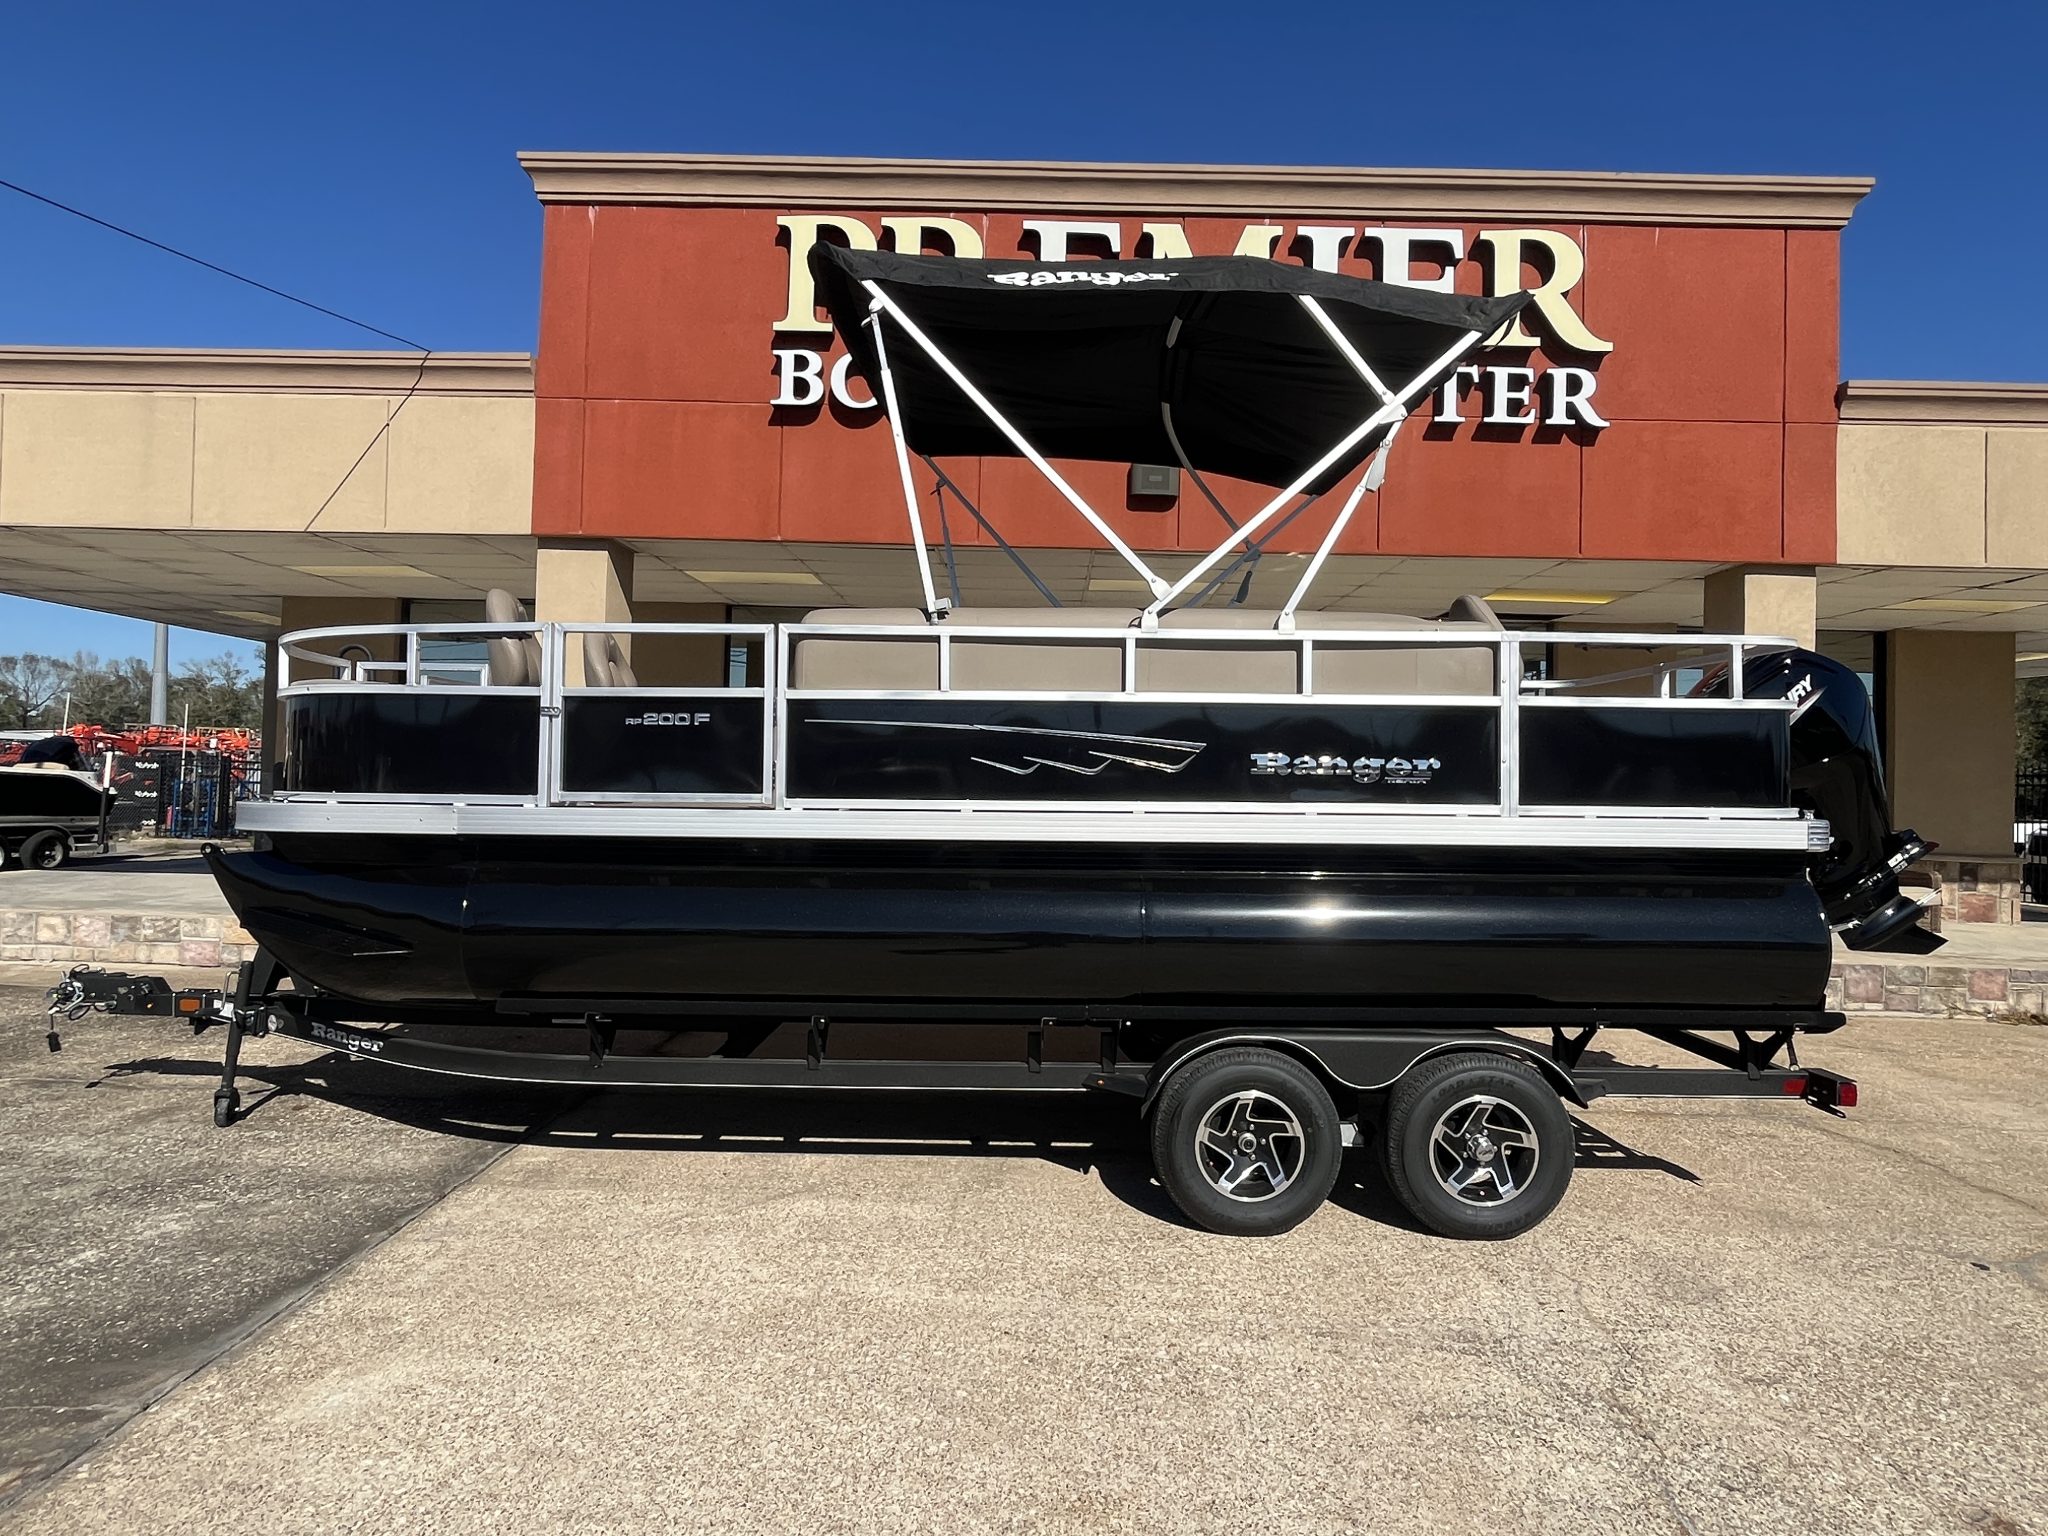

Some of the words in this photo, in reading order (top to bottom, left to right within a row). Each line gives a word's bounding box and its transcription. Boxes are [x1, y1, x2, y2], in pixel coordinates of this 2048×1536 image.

[987, 271, 1180, 286] Ranger
[1250, 752, 1441, 784] Ranger
[311, 1021, 384, 1052] Ranger
